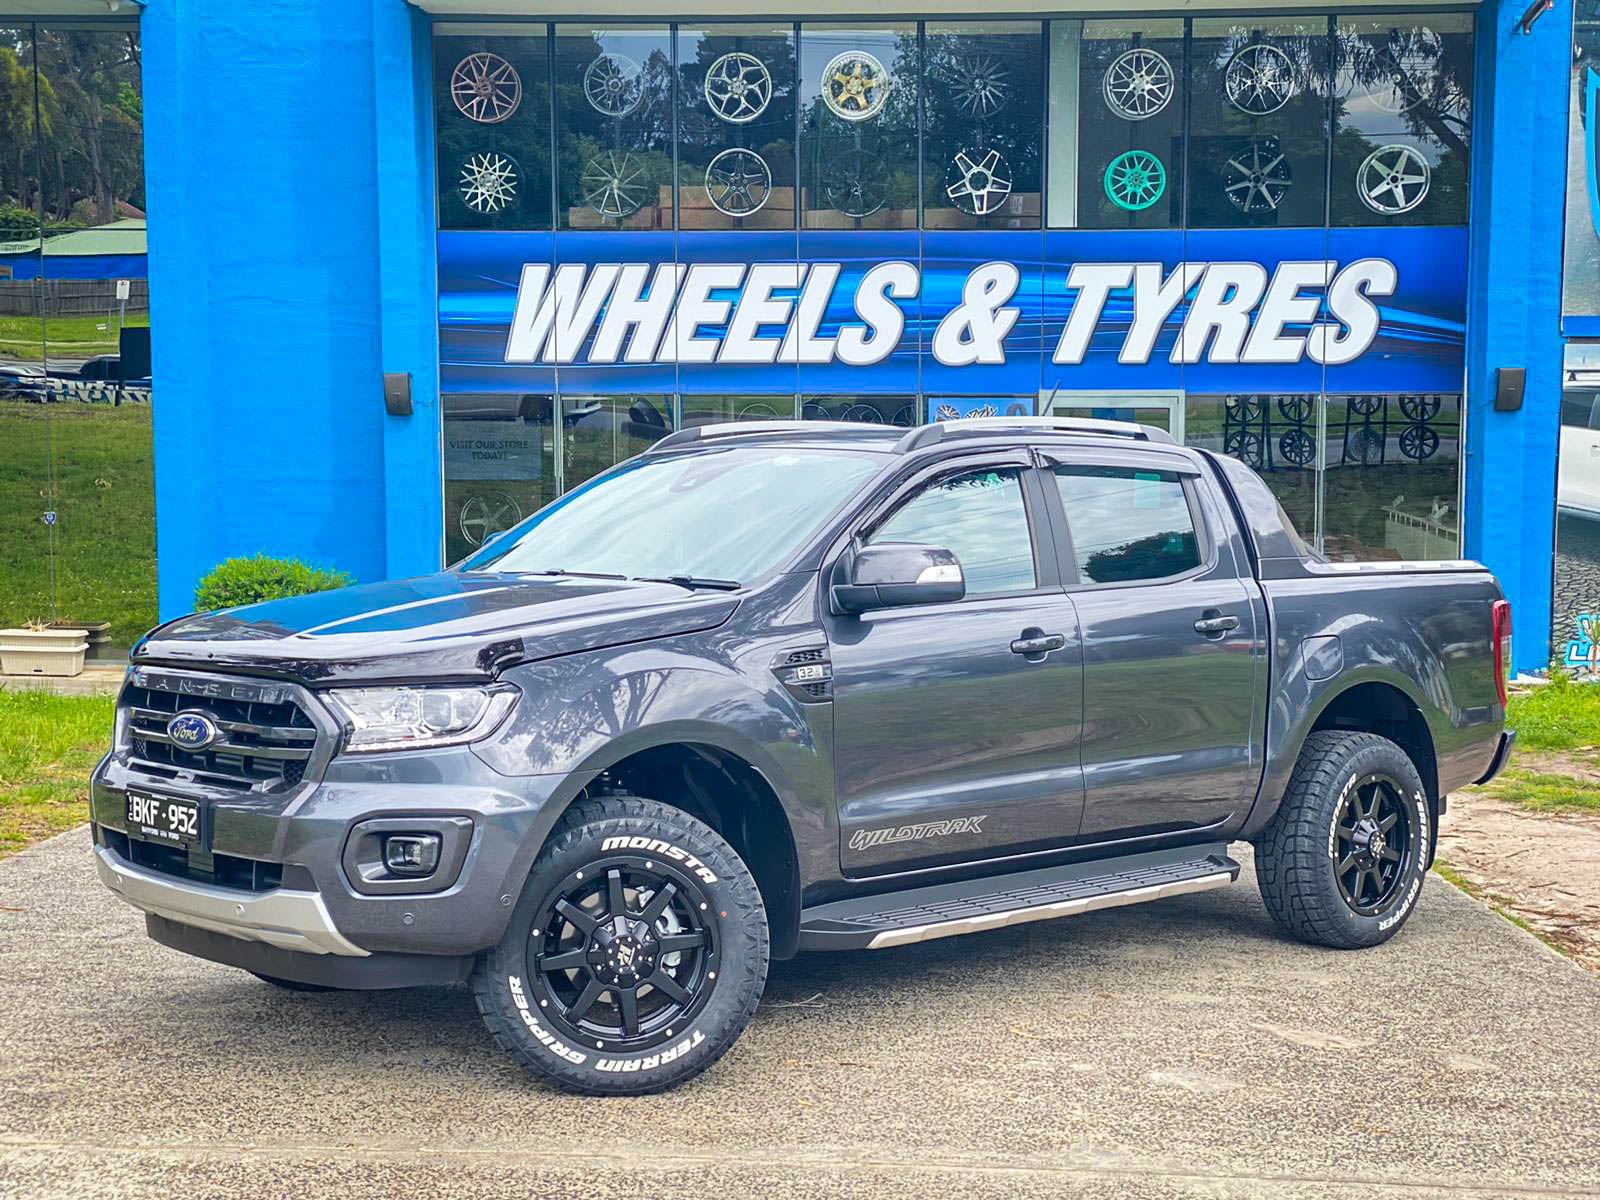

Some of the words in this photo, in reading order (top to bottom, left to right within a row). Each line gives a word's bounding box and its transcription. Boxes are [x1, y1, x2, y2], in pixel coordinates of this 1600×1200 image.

[505, 261, 921, 367] WHEELS
[932, 259, 1021, 366] &
[1052, 256, 1398, 366] TYRES
[449, 440, 474, 449] VISIT
[475, 440, 497, 449] OUR
[499, 440, 529, 449] STORE
[173, 718, 200, 741] Ford
[849, 814, 989, 852] WILDTRAK
[1414, 791, 1429, 873] TERRAIN
[601, 835, 718, 885] MONSTA
[1378, 877, 1421, 931] GRIPPER
[508, 975, 588, 1066] GRIPPER
[595, 1029, 707, 1073] TERRAIN
